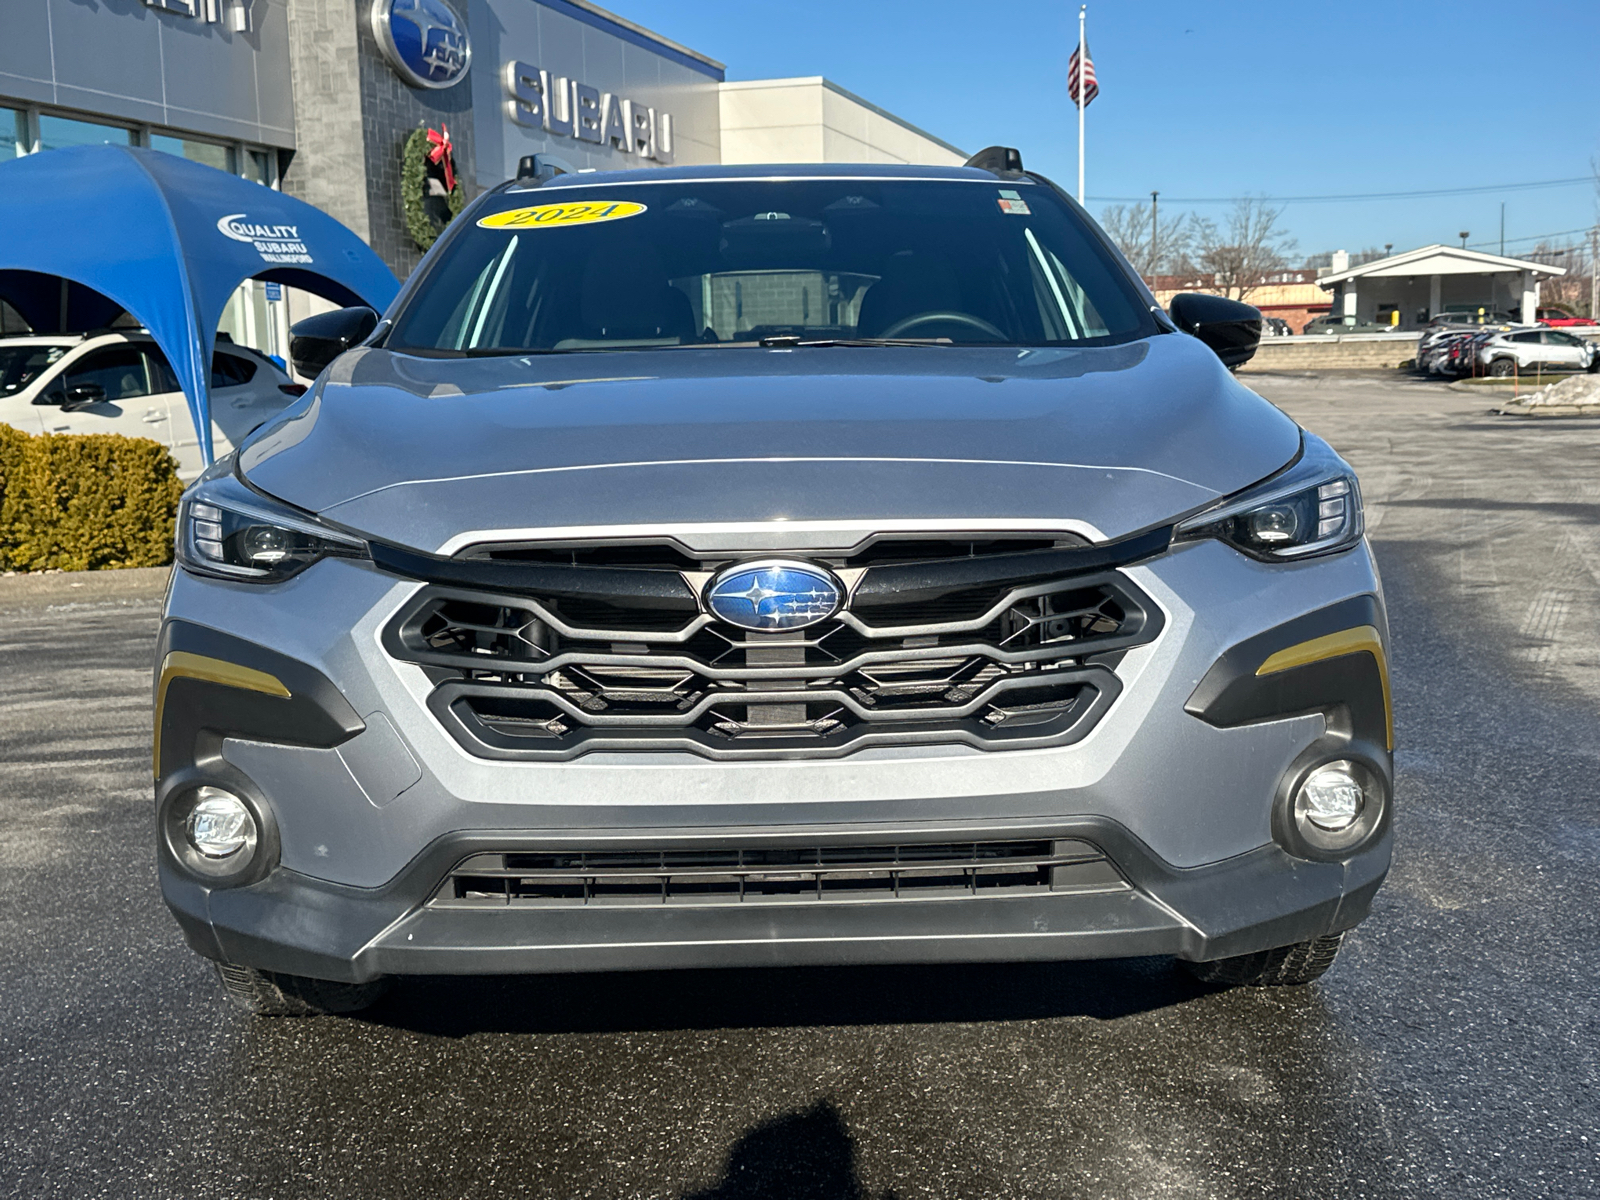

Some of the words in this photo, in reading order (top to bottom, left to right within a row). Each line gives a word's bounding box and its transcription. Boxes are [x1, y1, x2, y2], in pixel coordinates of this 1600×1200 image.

[505, 60, 675, 164] SUBARU
[504, 204, 620, 225] 2024
[230, 222, 298, 238] QUALITY
[253, 241, 307, 254] SUBARU
